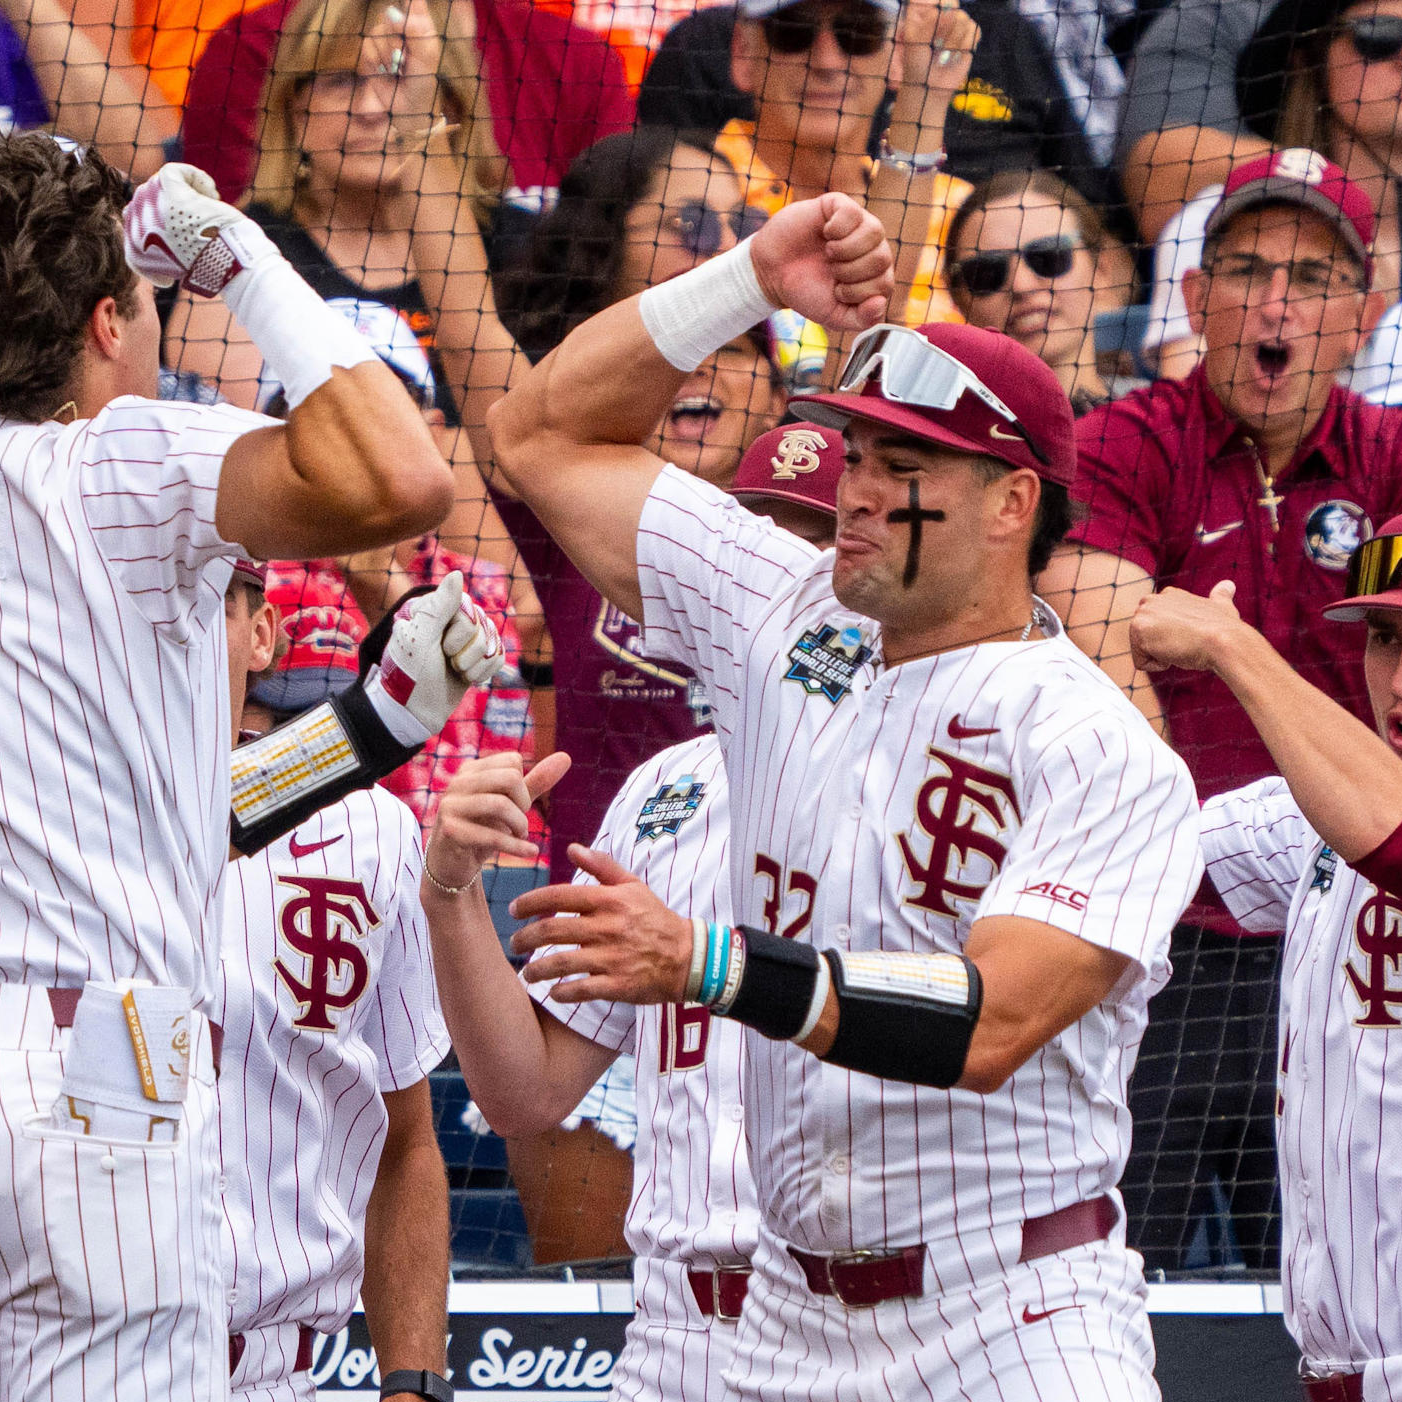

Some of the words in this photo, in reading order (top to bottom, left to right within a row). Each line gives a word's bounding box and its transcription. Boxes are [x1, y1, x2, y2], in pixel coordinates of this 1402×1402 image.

[789, 647, 828, 674] WORLD
[753, 851, 819, 940] 32
[1016, 880, 1091, 911] ACC
[468, 1326, 615, 1389] Serie
